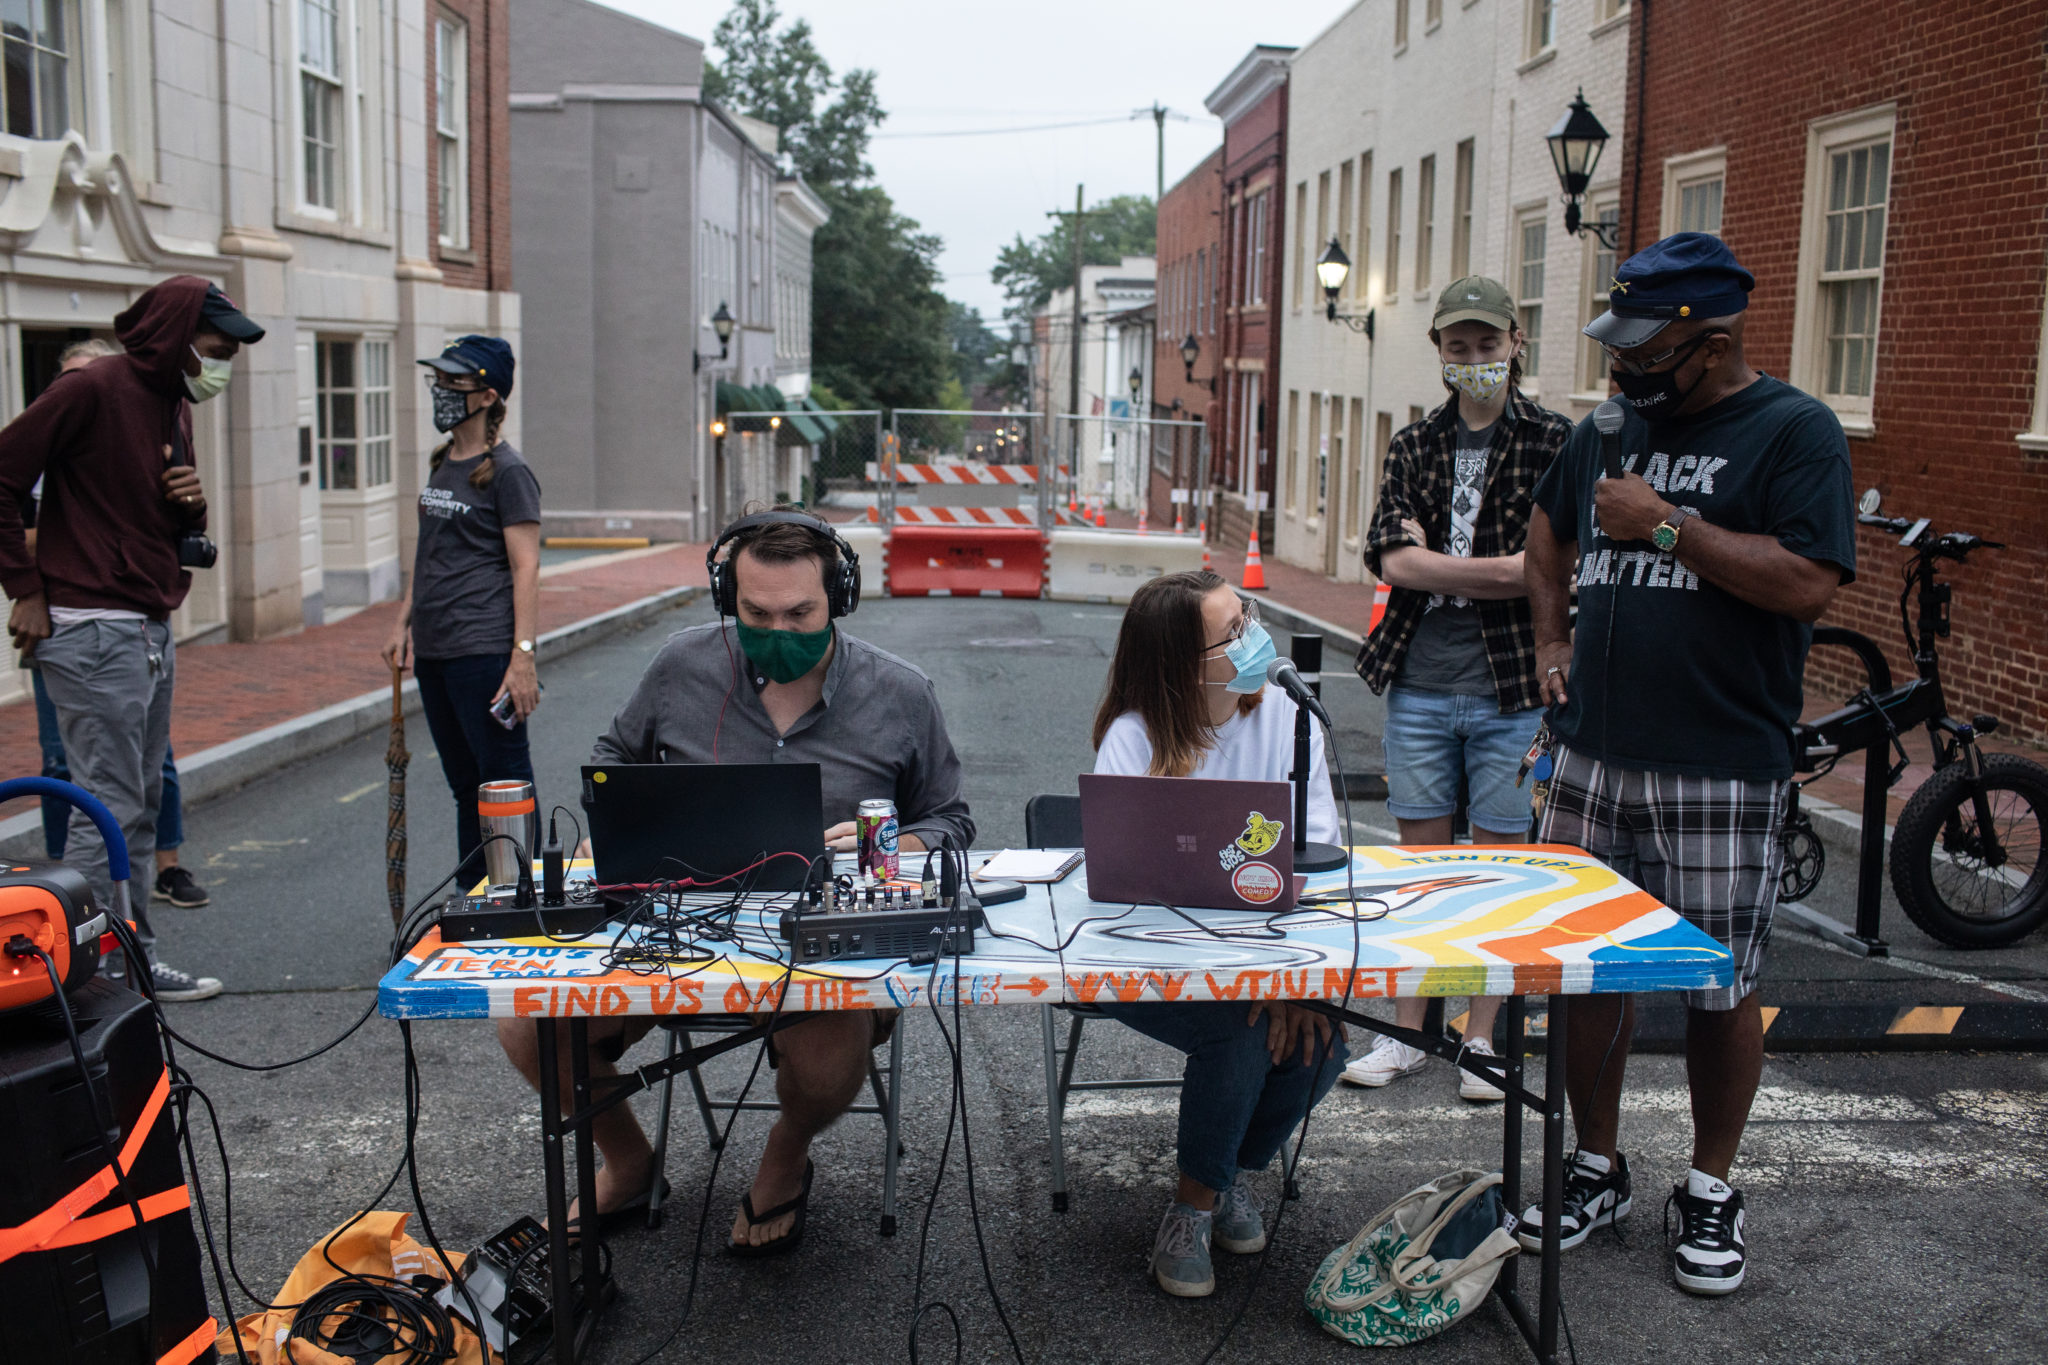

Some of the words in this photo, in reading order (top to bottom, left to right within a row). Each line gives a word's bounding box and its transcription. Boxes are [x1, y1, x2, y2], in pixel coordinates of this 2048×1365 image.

[1600, 452, 1728, 494] ACK
[422, 487, 453, 499] ELOVED
[420, 496, 471, 514] COMMUNITY
[1400, 855, 1478, 865] TERN
[1242, 887, 1275, 896] COMEDY
[929, 925, 966, 934] ALSS
[432, 956, 556, 973] TERN
[488, 969, 591, 980] TABLE
[513, 985, 632, 1018] FIND
[649, 980, 705, 1016] US
[723, 981, 787, 1014] ON
[790, 979, 876, 1012] THE
